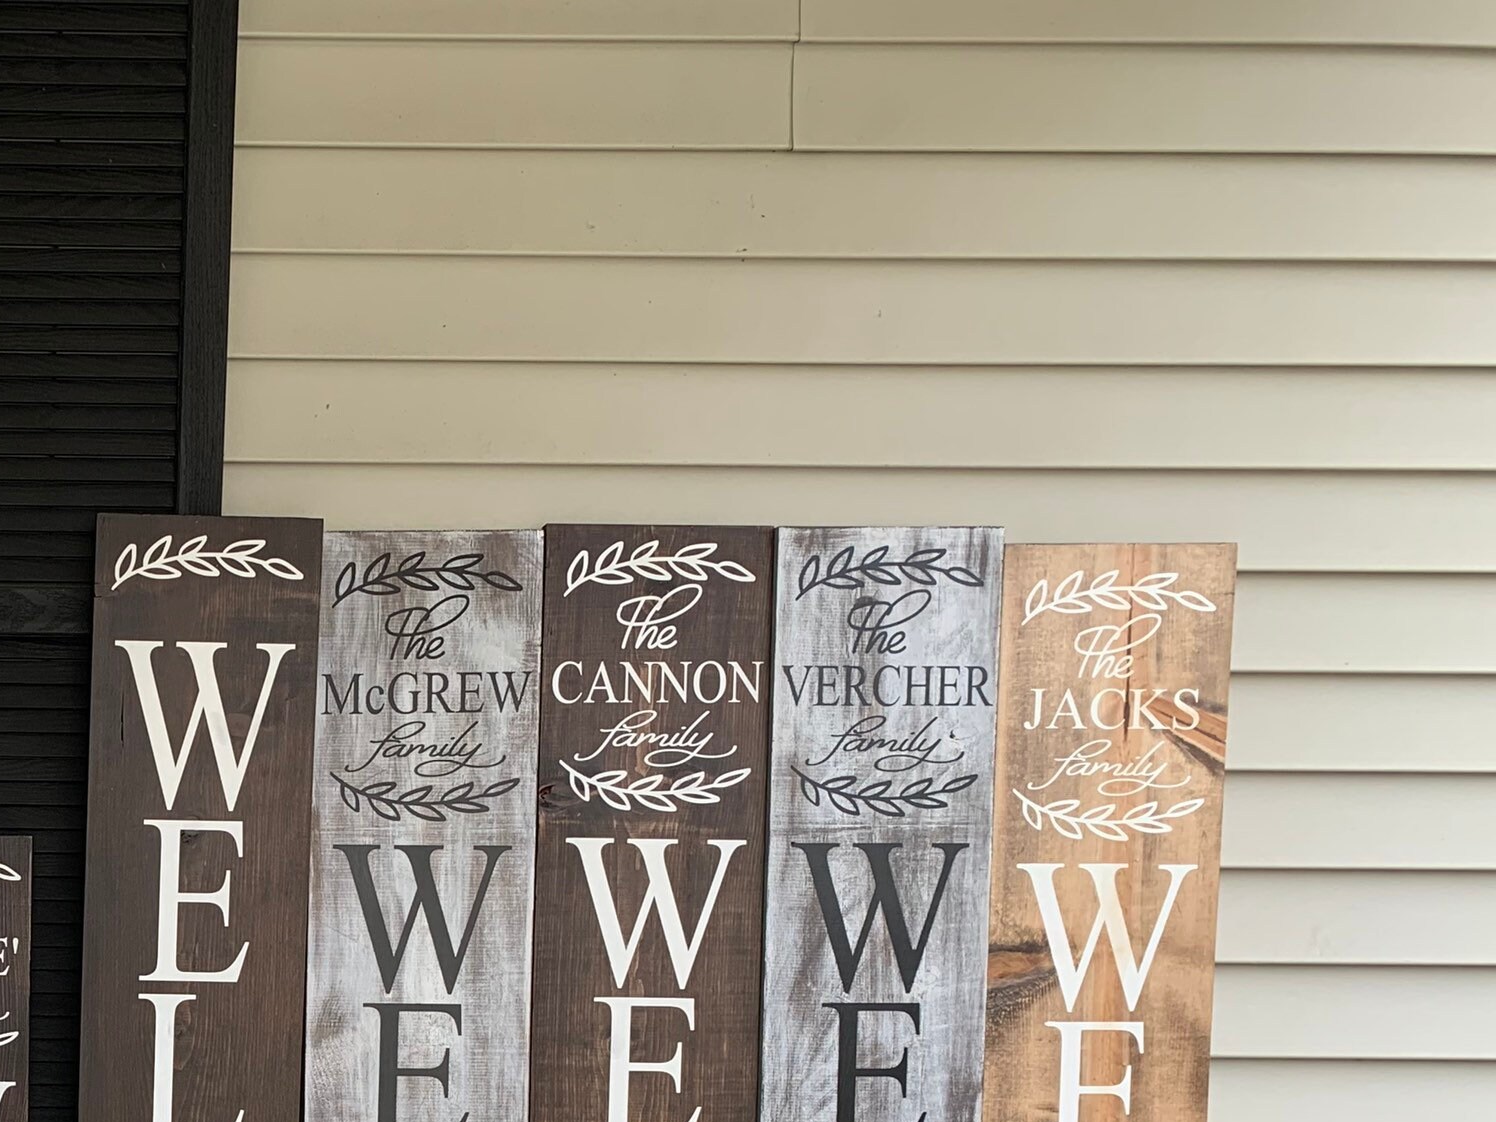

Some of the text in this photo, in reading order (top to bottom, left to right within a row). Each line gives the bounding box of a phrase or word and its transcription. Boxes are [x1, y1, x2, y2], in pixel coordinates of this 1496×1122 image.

[385, 595, 470, 662] The
[616, 584, 703, 651] The
[847, 588, 932, 656] The
[1074, 613, 1163, 681] The
[321, 669, 533, 717] McGREW
[550, 659, 765, 705] CANNON
[781, 663, 994, 708] VERCHER
[1022, 687, 1202, 733] JACKS
[345, 721, 507, 778] family
[573, 710, 738, 768] family
[805, 714, 966, 772] family
[1028, 738, 1193, 797] family
